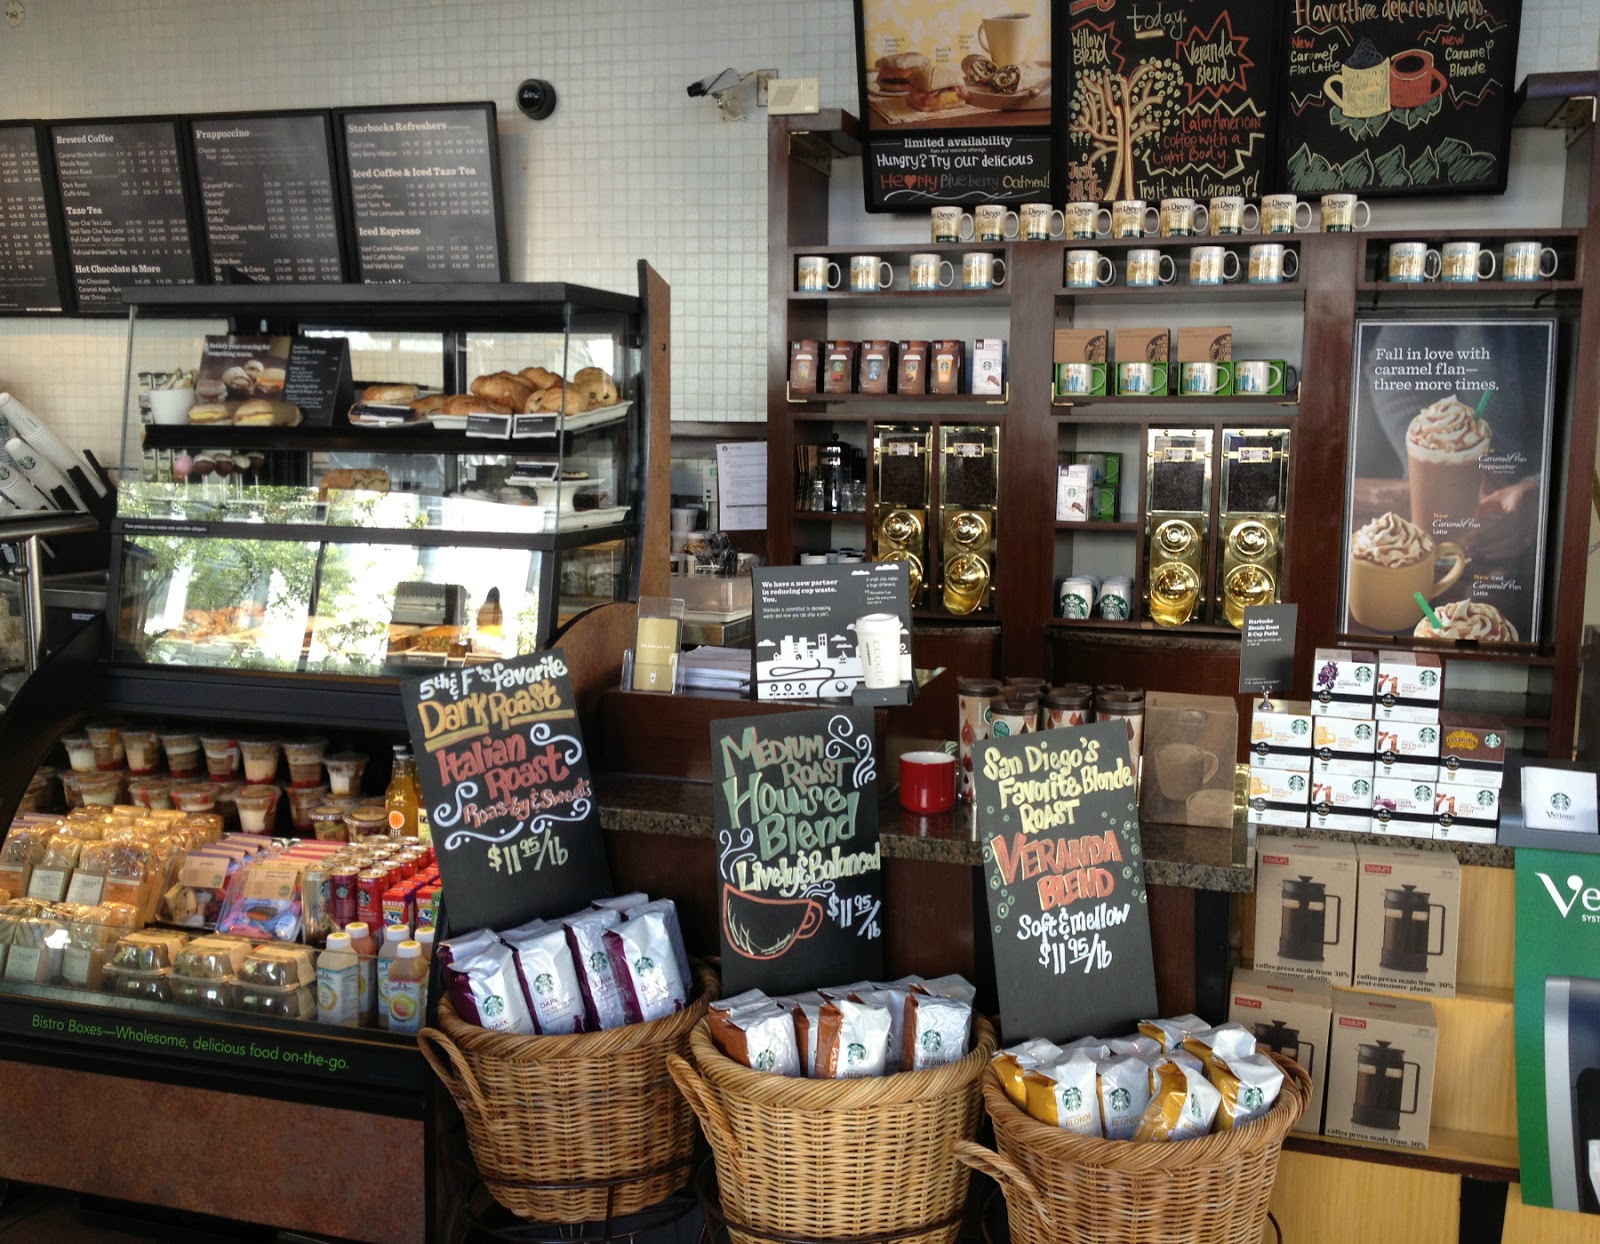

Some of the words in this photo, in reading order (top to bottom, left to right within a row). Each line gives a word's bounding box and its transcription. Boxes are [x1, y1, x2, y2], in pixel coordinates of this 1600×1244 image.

[1071, 28, 1107, 49] Willow
[1291, 37, 1316, 49] New
[1441, 34, 1465, 48] New
[1183, 28, 1237, 66] Veranda
[1290, 43, 1339, 62] Caramel
[1445, 40, 1494, 60] Caramel
[1073, 47, 1111, 66] Blend
[1196, 59, 1237, 85] Blend
[1289, 65, 1311, 76] Flan
[1312, 60, 1342, 73] Latte
[1449, 62, 1486, 77] Blonde
[348, 123, 394, 133] Starbucks
[395, 121, 447, 132] Refreshers
[1181, 110, 1212, 133] Latin
[1213, 109, 1262, 131] American
[56, 135, 87, 144] Brewed
[88, 134, 114, 143] Coffee
[196, 128, 250, 140] Frappuccino
[1163, 132, 1198, 149] coffee
[1199, 131, 1228, 146] with
[1231, 133, 1242, 145] a
[904, 137, 945, 148] limited
[947, 136, 1013, 148] availability
[876, 153, 928, 170] Hungry?
[929, 155, 951, 170] Try
[954, 156, 979, 169] our
[981, 154, 1034, 167] delicious
[353, 169, 372, 178] Iced
[373, 168, 402, 178] Coffee
[404, 168, 411, 177] &
[412, 167, 432, 177] Iced
[433, 167, 456, 176] Tazo
[458, 166, 476, 175] Tea
[880, 174, 938, 192] Herty
[941, 173, 1000, 190] Blueberry
[1171, 176, 1199, 198] with
[66, 206, 86, 215] Tazo
[87, 206, 102, 214] Tea
[1171, 203, 1191, 213] Diego
[1220, 201, 1240, 211] Diego
[1272, 199, 1292, 209] Diego
[359, 227, 378, 236] Iced
[380, 226, 421, 237] Espresso
[75, 265, 90, 273] Hot
[91, 265, 130, 273] Chocolate
[131, 265, 138, 273] &
[138, 265, 161, 273] More
[1375, 348, 1403, 361] Fall
[1407, 347, 1421, 360] in
[1424, 348, 1453, 361] love
[1457, 347, 1491, 360] with
[1374, 363, 1432, 376] caramel
[1374, 379, 1412, 391] three
[1414, 380, 1452, 391] more
[1455, 379, 1499, 391] times.
[775, 580, 790, 588] have
[811, 579, 838, 588] partner
[770, 588, 800, 597] reducing
[801, 588, 814, 596] cup
[490, 655, 568, 691] favorite
[417, 692, 490, 739] Dark
[488, 680, 562, 731] Roast
[435, 733, 527, 787] Italian
[983, 747, 1024, 781] San
[1024, 736, 1101, 776] Diego's
[484, 744, 570, 805] Roast
[998, 771, 1083, 810] Favorite
[1080, 757, 1134, 795] Blonde
[722, 771, 848, 829] House
[757, 791, 860, 861] Blend
[735, 857, 800, 897] Lively
[809, 842, 881, 884] Balanced
[1037, 867, 1115, 911] BLEND
[1017, 912, 1058, 944] Soft
[1070, 902, 1130, 935] mellow
[1357, 974, 1377, 982] coffee
[1379, 975, 1397, 984] press
[1398, 977, 1418, 985] made
[1419, 979, 1436, 987] from
[489, 1019, 509, 1030] DARK
[1340, 1019, 1366, 1028] bodum
[32, 1014, 65, 1031] Bistro
[193, 1036, 246, 1056] delicious
[249, 1043, 279, 1060] food
[282, 1050, 350, 1071] on-the-go.
[920, 1058, 950, 1067] MEDIUM
[1065, 1113, 1092, 1126] BLONDE
